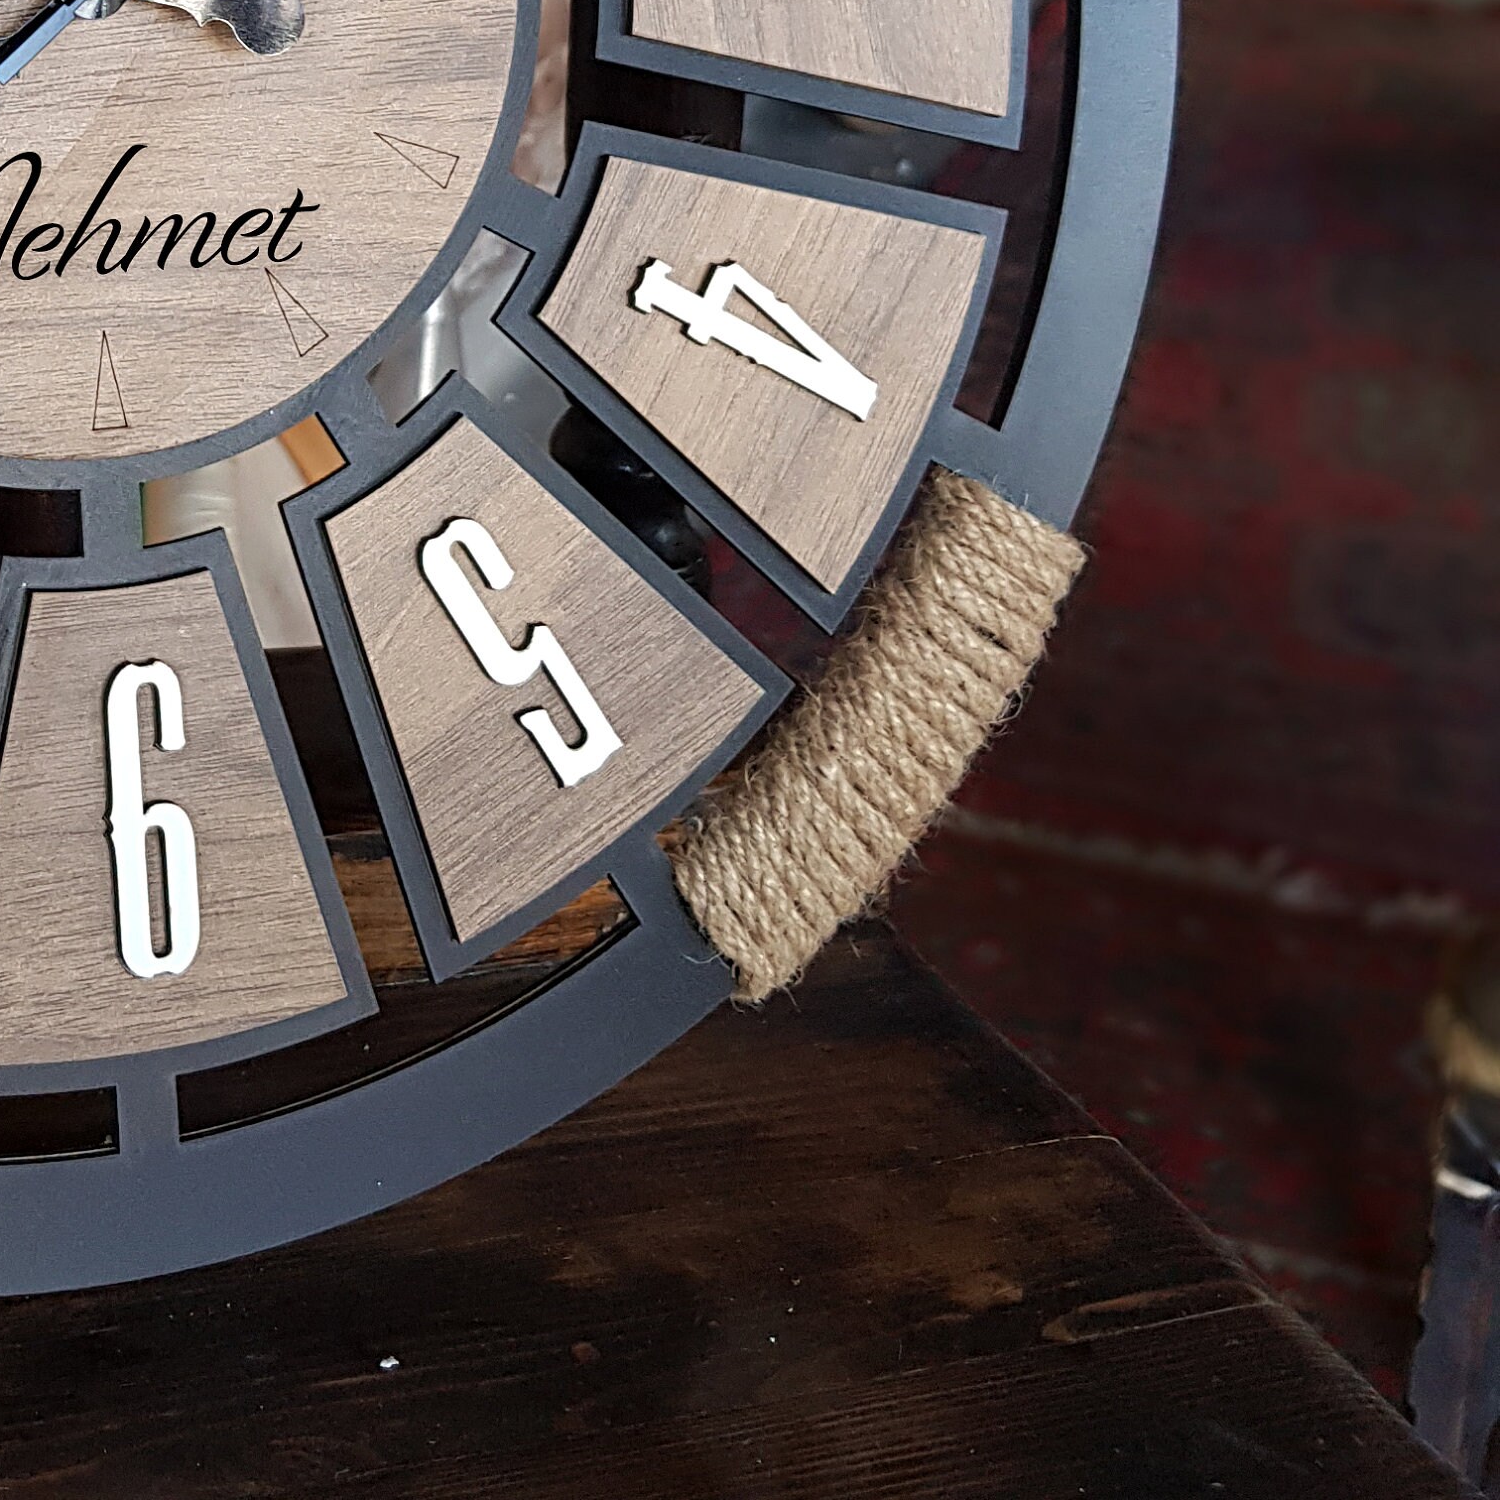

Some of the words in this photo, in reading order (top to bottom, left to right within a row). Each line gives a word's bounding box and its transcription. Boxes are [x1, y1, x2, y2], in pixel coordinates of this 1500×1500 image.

[629, 257, 879, 423] 4
[417, 516, 624, 789] 5
[104, 658, 201, 980] 6
